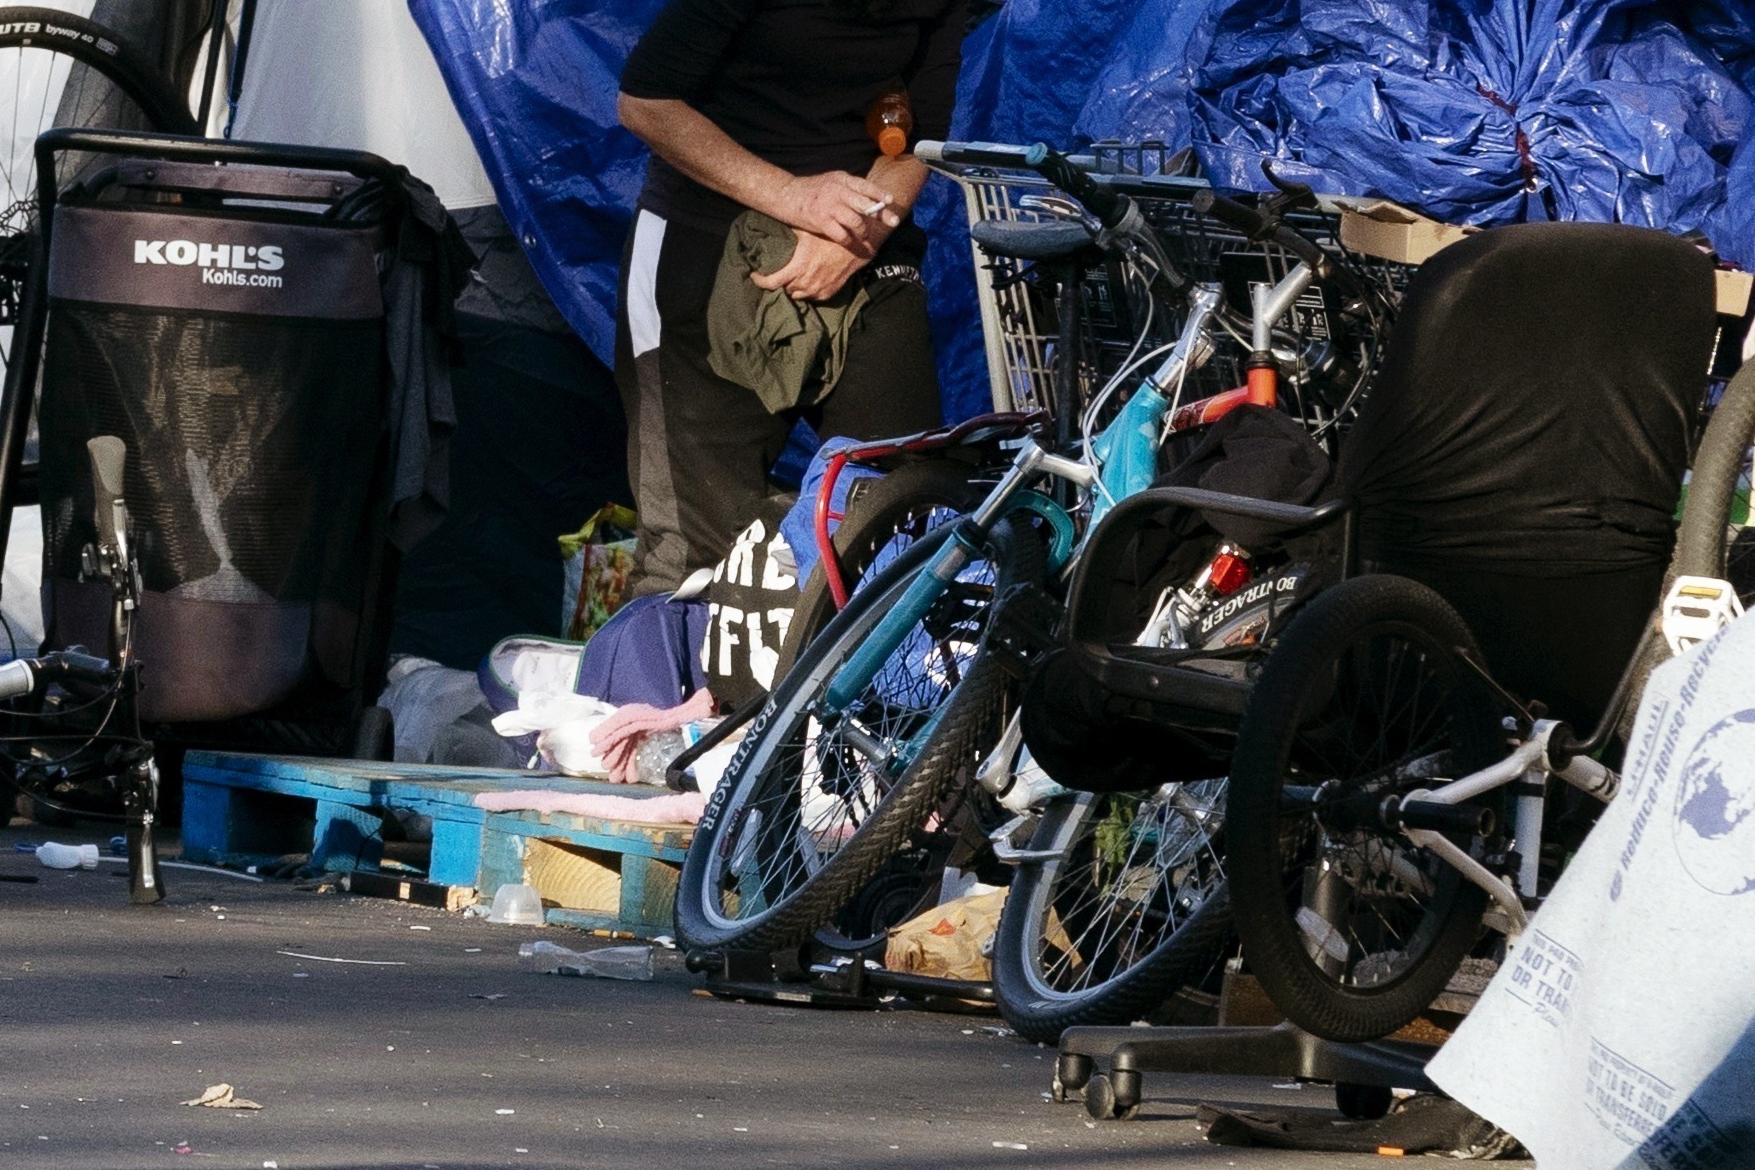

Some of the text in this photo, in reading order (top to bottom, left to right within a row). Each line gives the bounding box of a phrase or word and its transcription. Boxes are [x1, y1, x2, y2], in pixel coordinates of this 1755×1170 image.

[45, 24, 80, 40] byway
[81, 33, 94, 44] 40
[134, 240, 285, 271] KOHL'S
[202, 268, 283, 288] Kohls.com
[702, 698, 778, 830] BONTRAGER
[1512, 964, 1571, 1012] OR TRAN
[1521, 945, 1573, 990] NOT TO
[1606, 1069, 1619, 1091] TO
[1621, 1080, 1636, 1102] BE
[1639, 1090, 1668, 1122] SOLD
